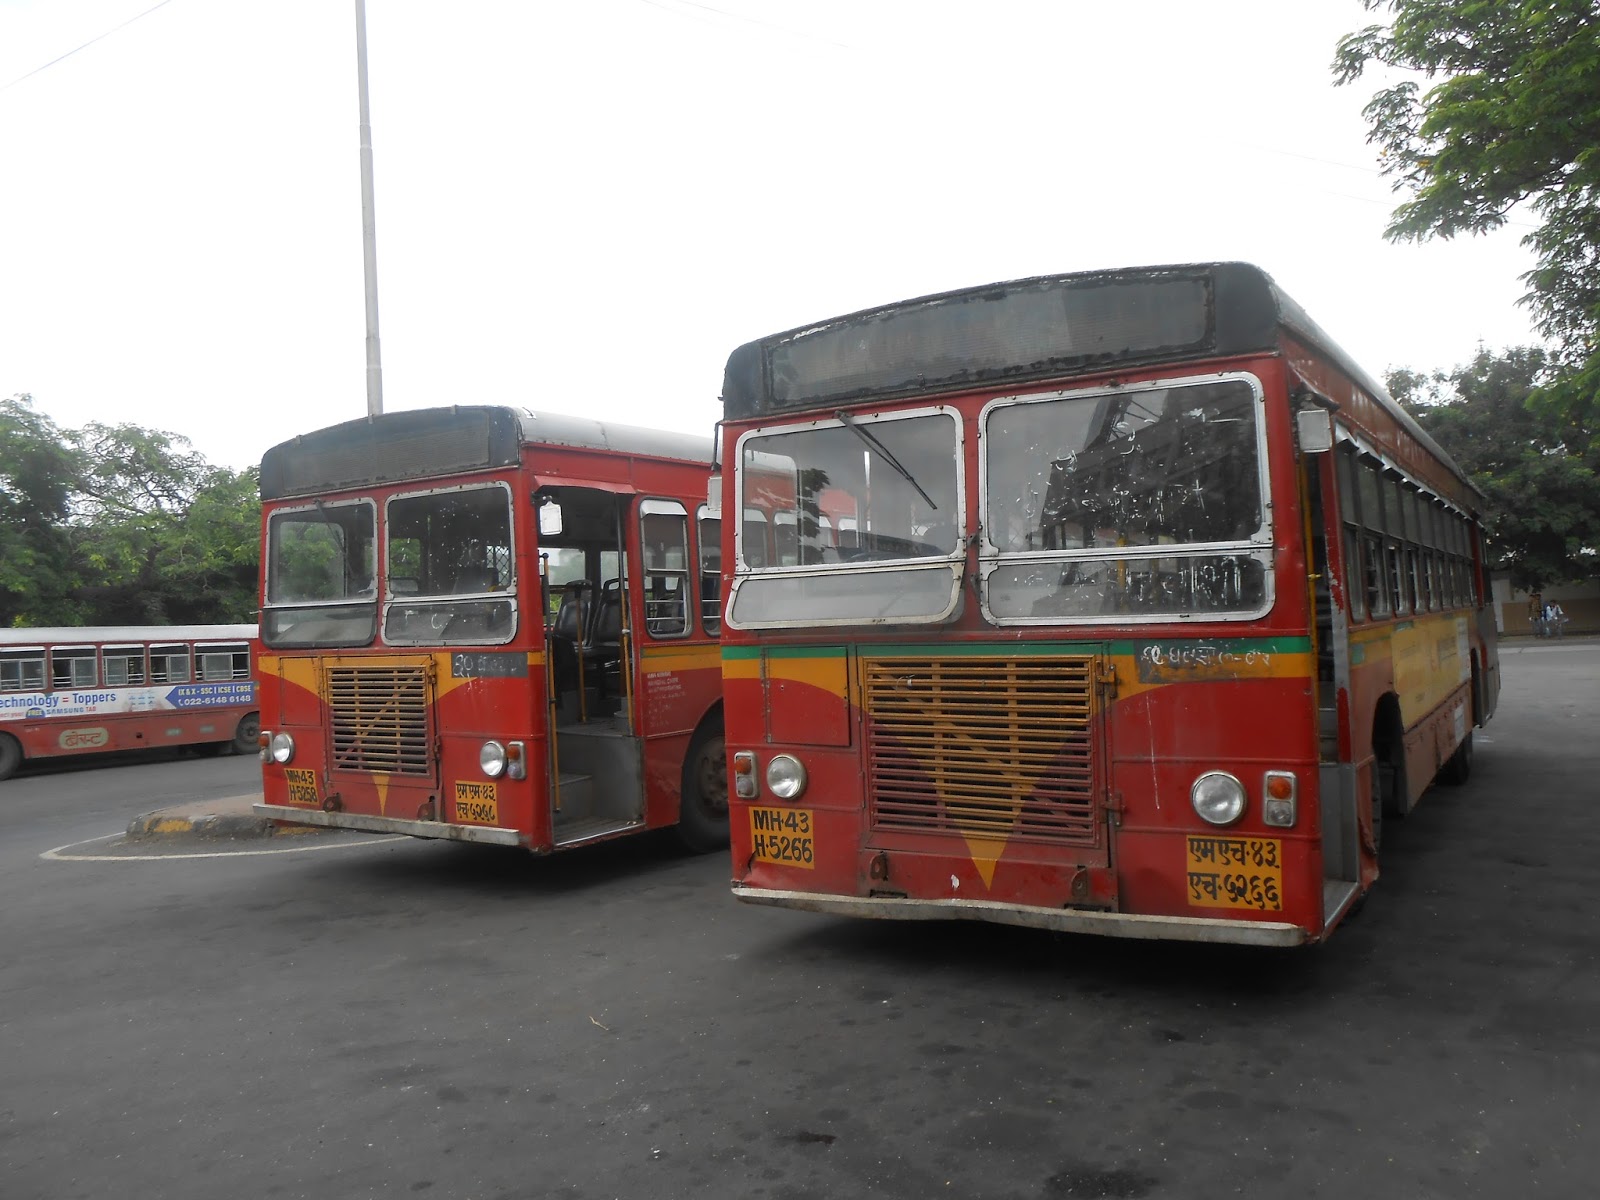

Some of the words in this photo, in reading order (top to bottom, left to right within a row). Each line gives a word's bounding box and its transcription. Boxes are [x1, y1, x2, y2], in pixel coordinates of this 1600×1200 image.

[72, 693, 117, 705] Toppers
[184, 696, 227, 706] 022-6148
[46, 707, 84, 715] SAMSUNG
